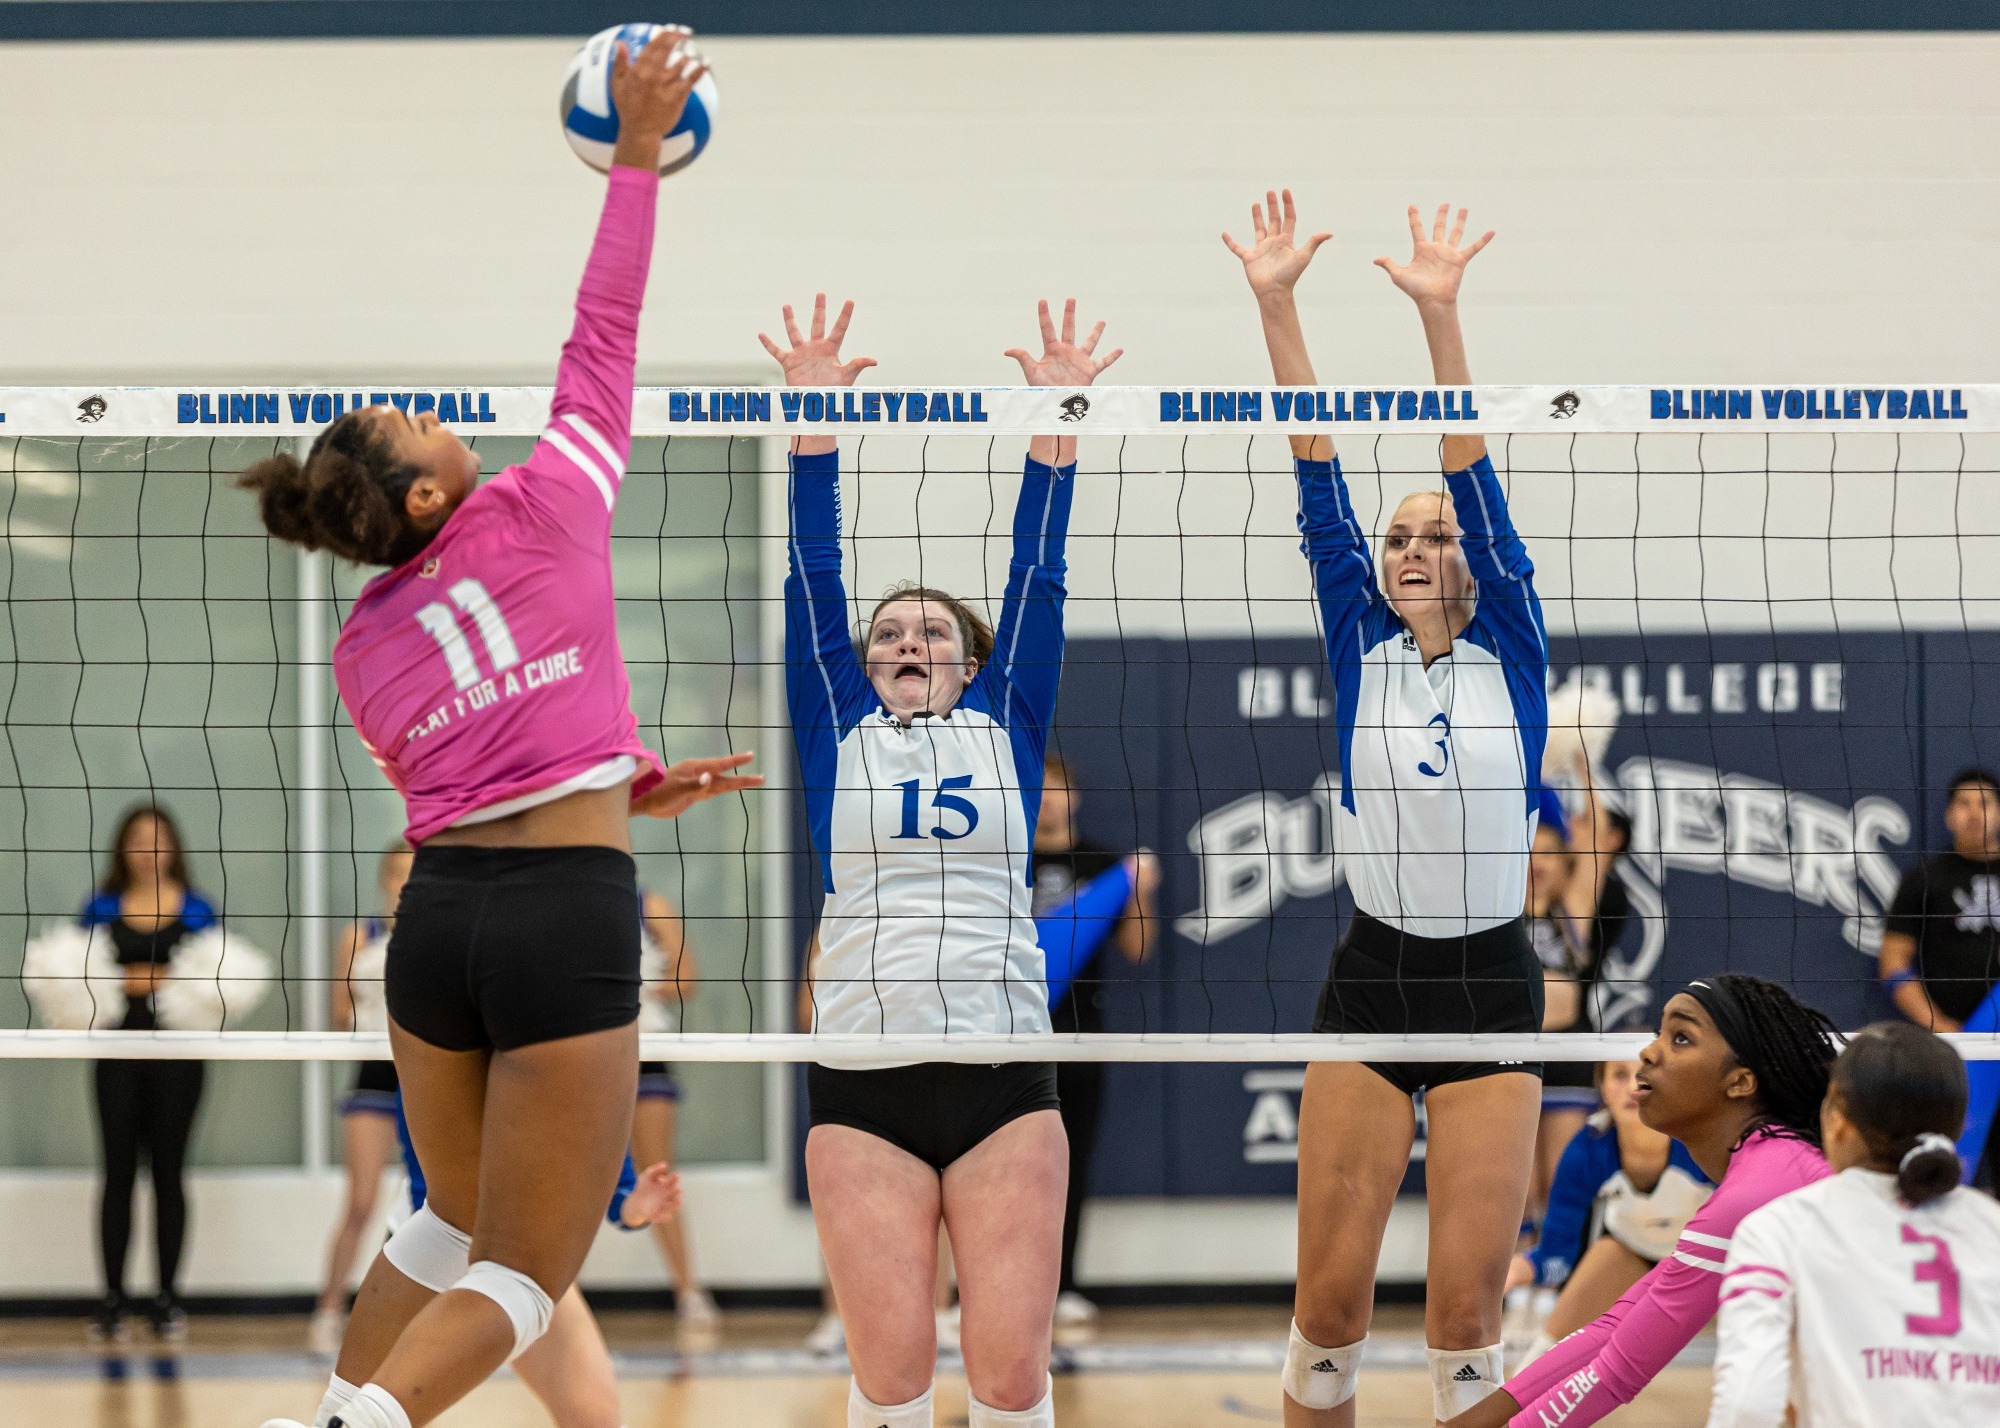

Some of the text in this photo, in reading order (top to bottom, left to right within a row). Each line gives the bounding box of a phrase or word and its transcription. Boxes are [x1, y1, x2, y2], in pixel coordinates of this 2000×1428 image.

[177, 393, 279, 424] BLINN
[669, 391, 988, 422] BLINN VOLLEYBALL
[1160, 390, 1479, 422] BLINN VOLLEYBALL
[1650, 389, 1968, 420] BLINN VOLLEYBALL
[414, 577, 521, 692] 11
[505, 671, 522, 698] A
[523, 646, 584, 690] CURE
[1417, 712, 1451, 778] 3
[890, 774, 979, 840] 15
[1899, 1222, 1962, 1338] 3
[1453, 1374, 1482, 1382] adidas
[1861, 1347, 1939, 1381] THINK
[1537, 1364, 1600, 1428] PRETTY
